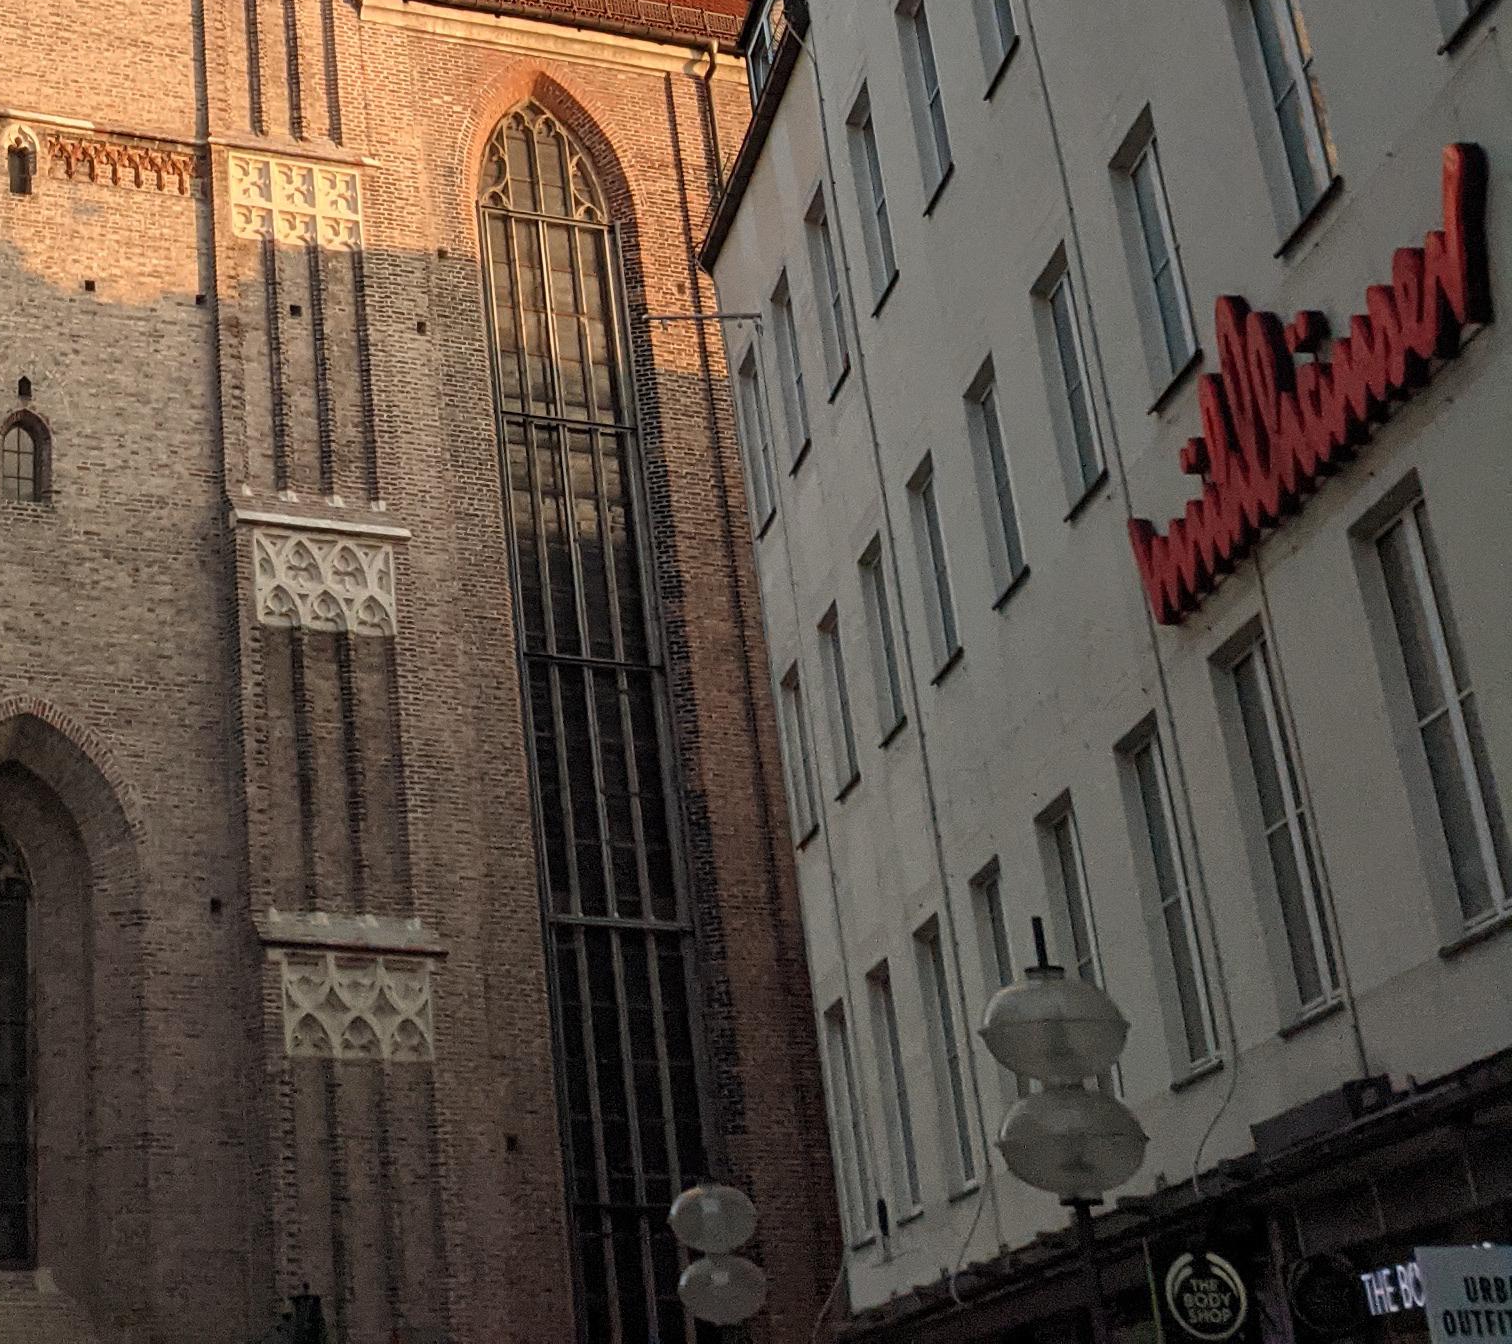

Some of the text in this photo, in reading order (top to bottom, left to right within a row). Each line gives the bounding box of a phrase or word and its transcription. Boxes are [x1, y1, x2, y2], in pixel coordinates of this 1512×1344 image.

[1190, 1279, 1221, 1292] THE
[1359, 1268, 1399, 1316] THE
[1183, 1292, 1232, 1308] BODY
[1187, 1307, 1233, 1324] SHOP
